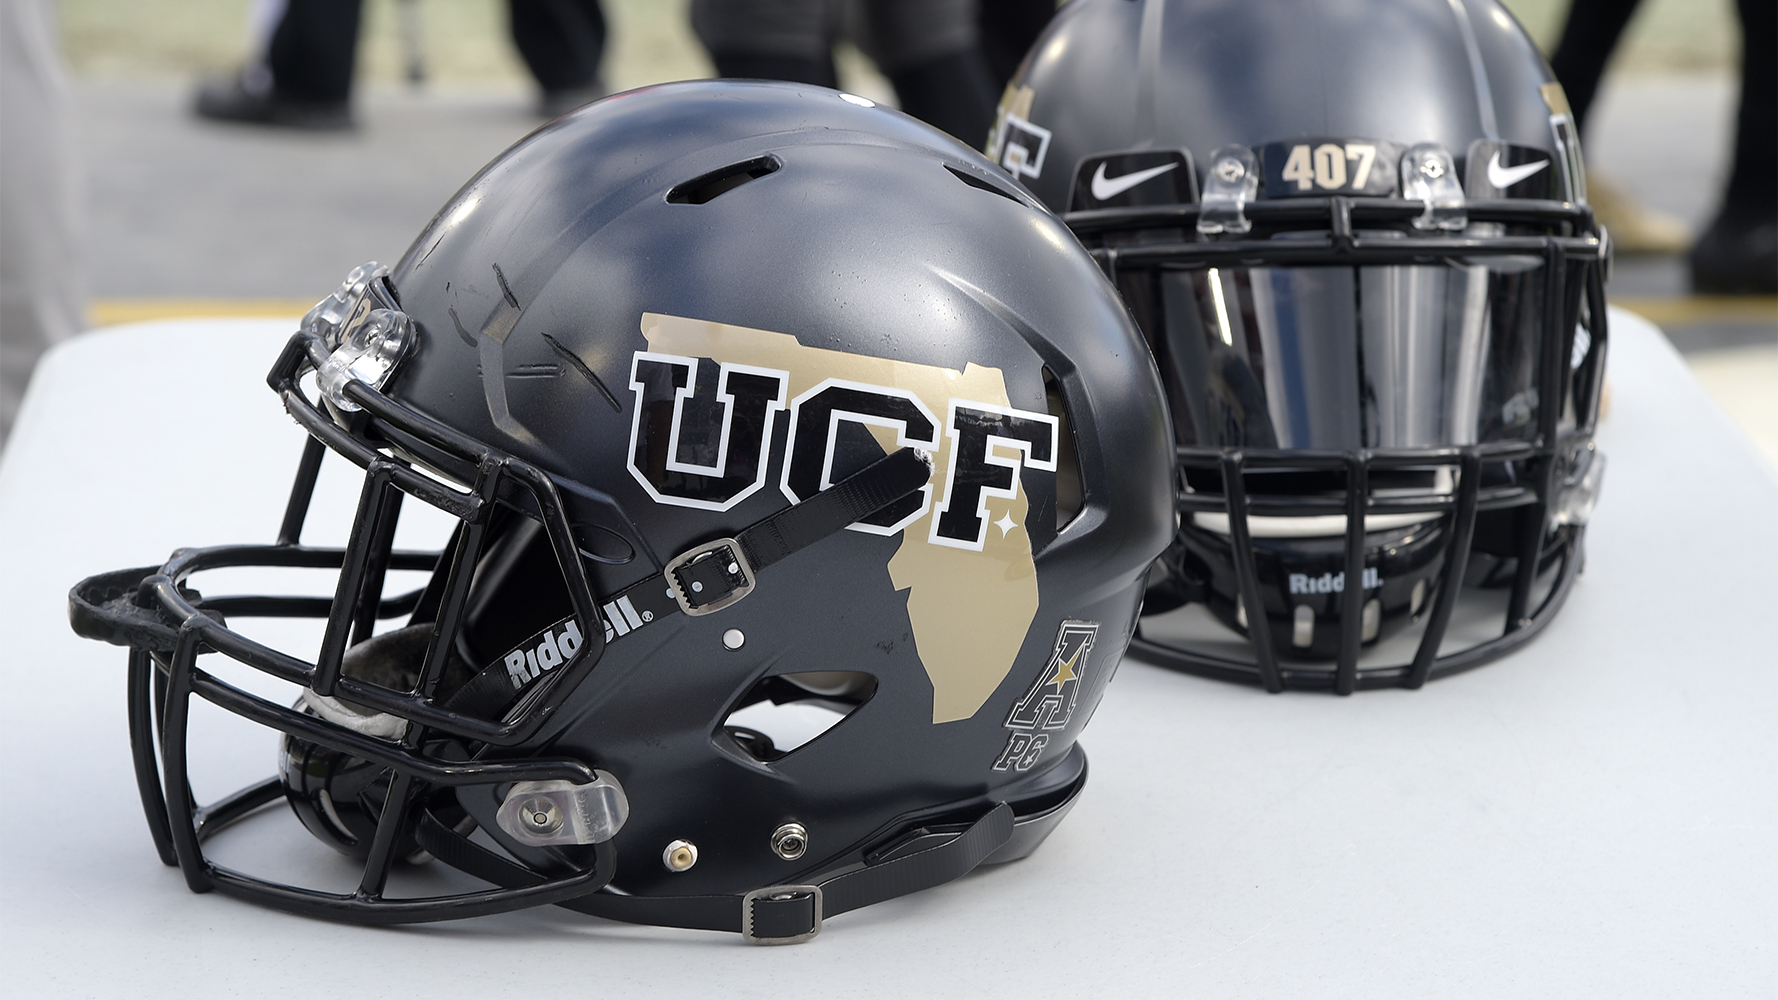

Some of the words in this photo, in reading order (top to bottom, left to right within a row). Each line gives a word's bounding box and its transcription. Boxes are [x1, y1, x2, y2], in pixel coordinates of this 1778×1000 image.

[1282, 143, 1376, 190] 407
[626, 350, 1059, 552] UCF
[1289, 567, 1385, 594] Riddll
